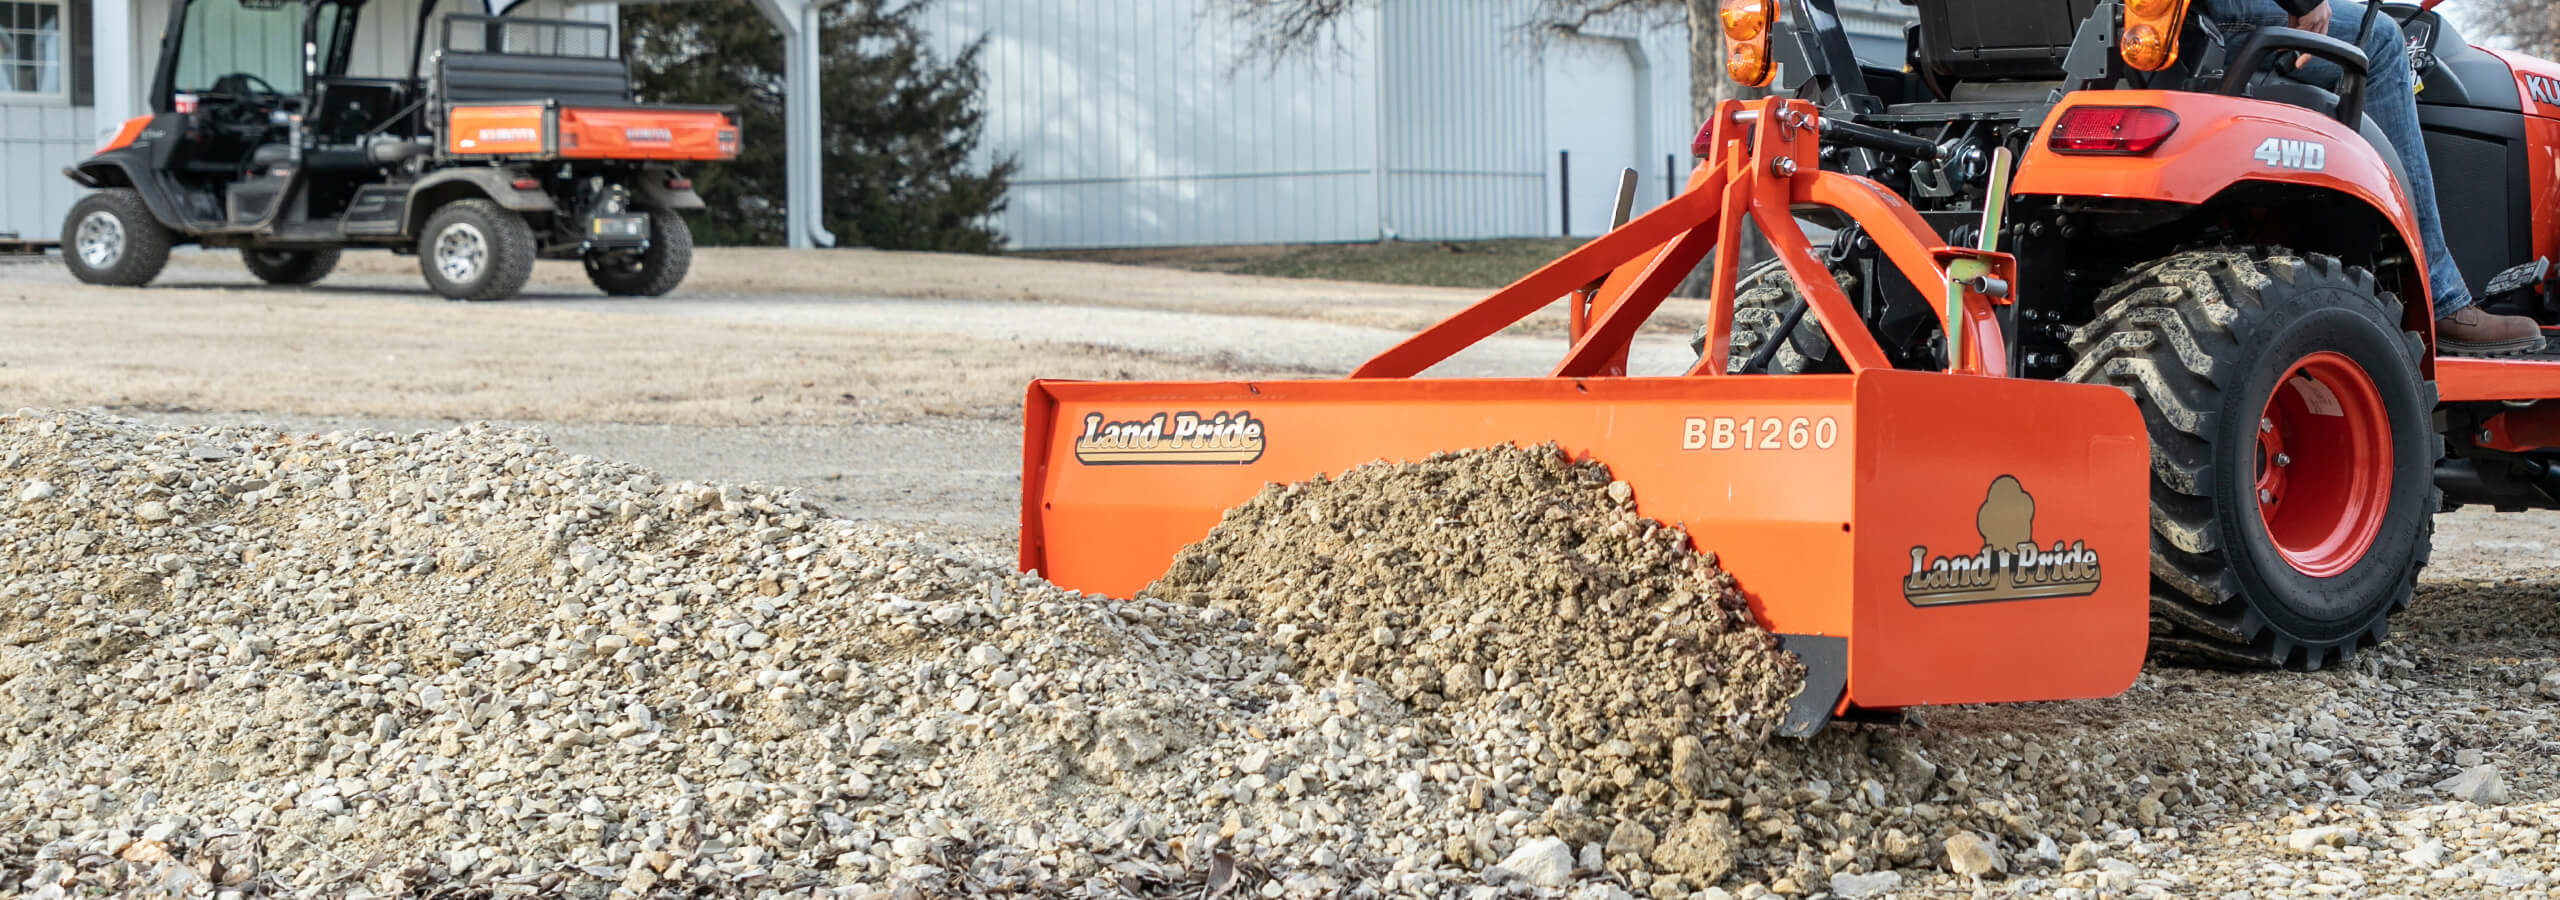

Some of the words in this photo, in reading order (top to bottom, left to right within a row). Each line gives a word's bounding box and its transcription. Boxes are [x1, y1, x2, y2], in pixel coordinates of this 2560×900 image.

[2253, 136, 2326, 171] 4WD
[1078, 412, 1167, 450] Land
[1170, 411, 1264, 450] Pride
[1683, 416, 1838, 450] BB1260
[1907, 544, 1994, 591] Land
[2013, 538, 2100, 583] Pride
